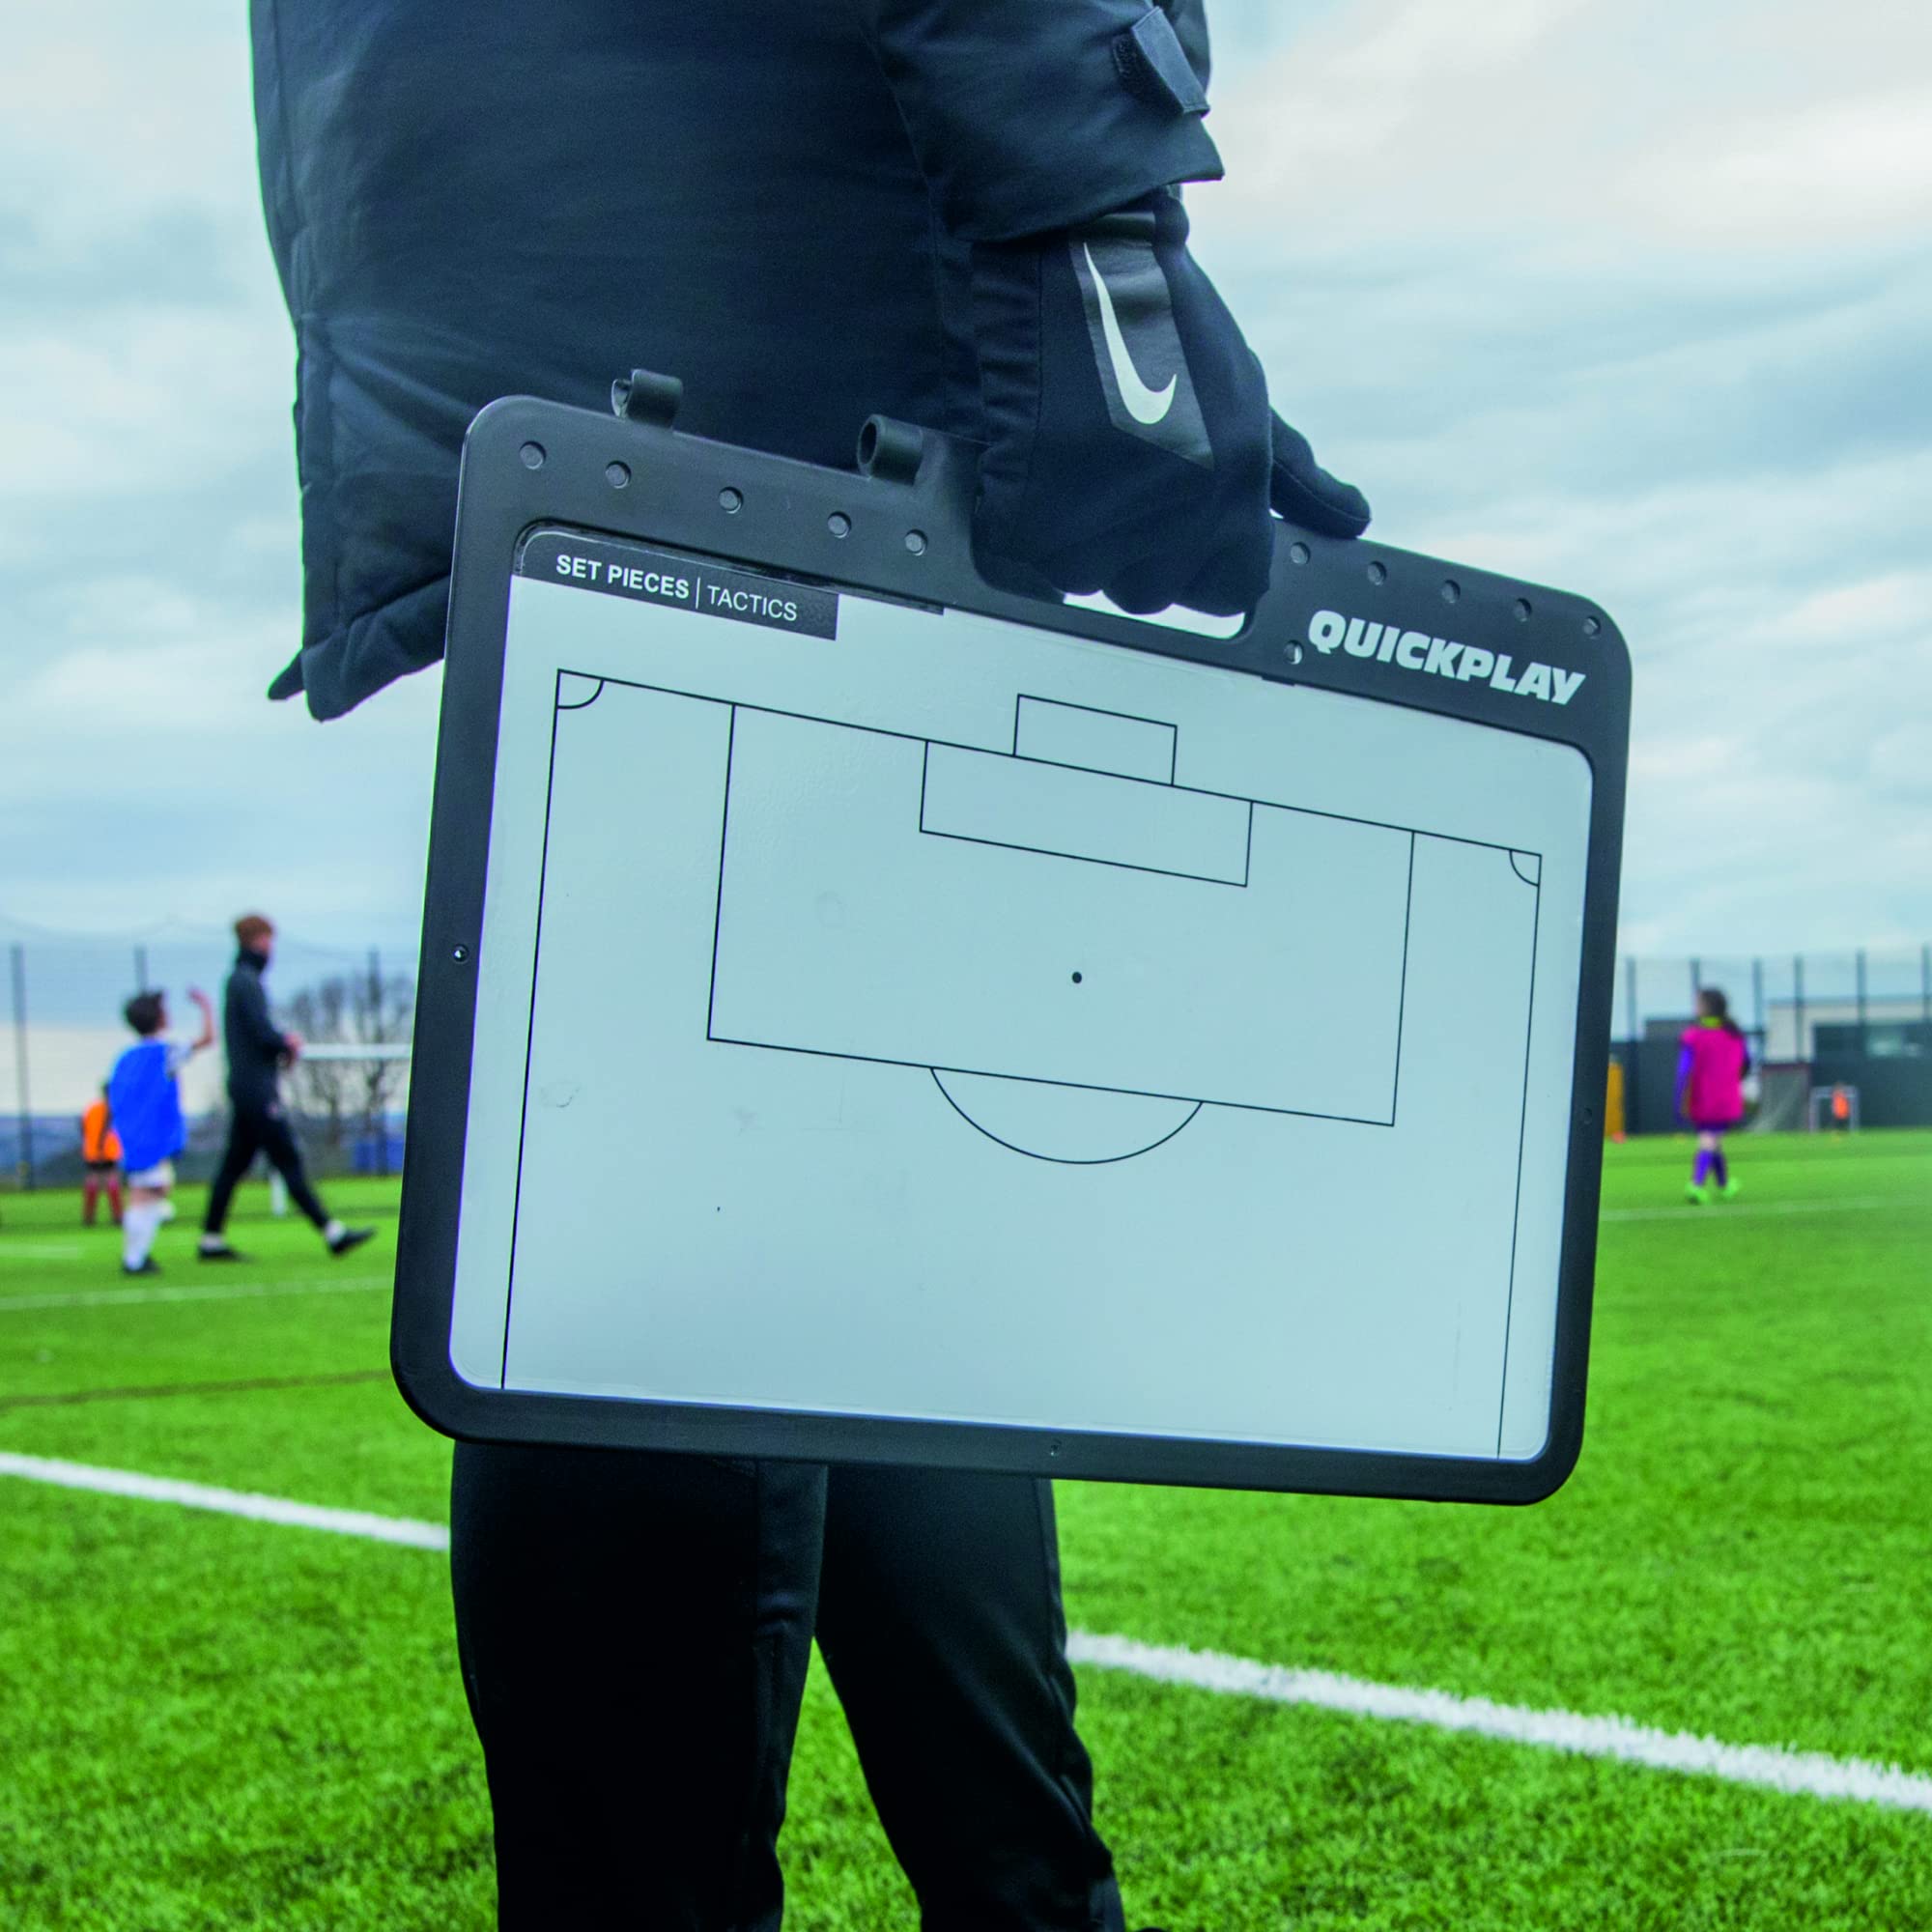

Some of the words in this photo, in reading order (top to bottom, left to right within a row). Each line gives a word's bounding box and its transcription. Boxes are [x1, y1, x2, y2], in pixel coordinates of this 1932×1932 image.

[555, 554, 602, 581] SET
[607, 564, 690, 599] PIECES
[706, 584, 798, 621] TACTICS
[1307, 609, 1586, 706] QUICKPLAY
